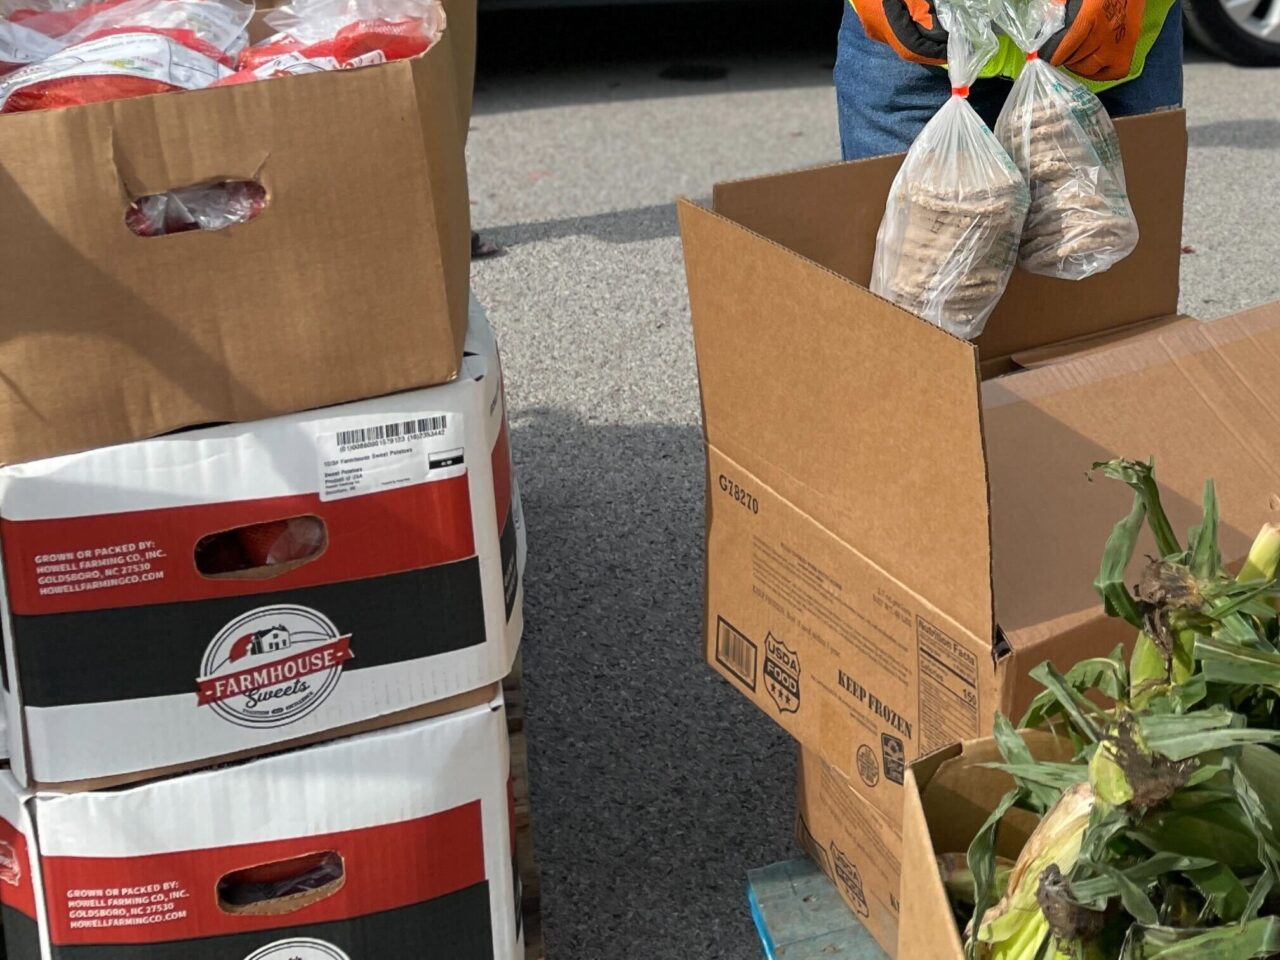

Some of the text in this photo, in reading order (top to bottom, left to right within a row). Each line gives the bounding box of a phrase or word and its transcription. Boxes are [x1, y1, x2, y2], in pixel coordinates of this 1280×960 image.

[34, 540, 156, 564] GROWN OR PACKED BY:
[36, 562, 78, 574] HOWELL
[79, 555, 125, 570] FARMING
[145, 549, 167, 560] INC.
[38, 562, 151, 585] GOLDSBORO, NC 27530
[39, 571, 165, 596] HOWELLFARMINGCO.COM
[767, 640, 798, 672] USDA
[214, 649, 336, 697] FARMHOUSE
[767, 661, 797, 693] FOOD
[243, 678, 311, 709] Sweets
[837, 669, 868, 703] KEEP
[868, 691, 913, 740] FROZEN
[67, 881, 179, 898] GROWN OR PACKED BY:
[68, 898, 107, 908] HOWELL
[107, 895, 150, 907] FARMING
[169, 889, 190, 900] INC.
[69, 902, 175, 919] GOLDSBORO, NC 27530
[70, 910, 187, 929] HOWELLFARMINGCO.COM
